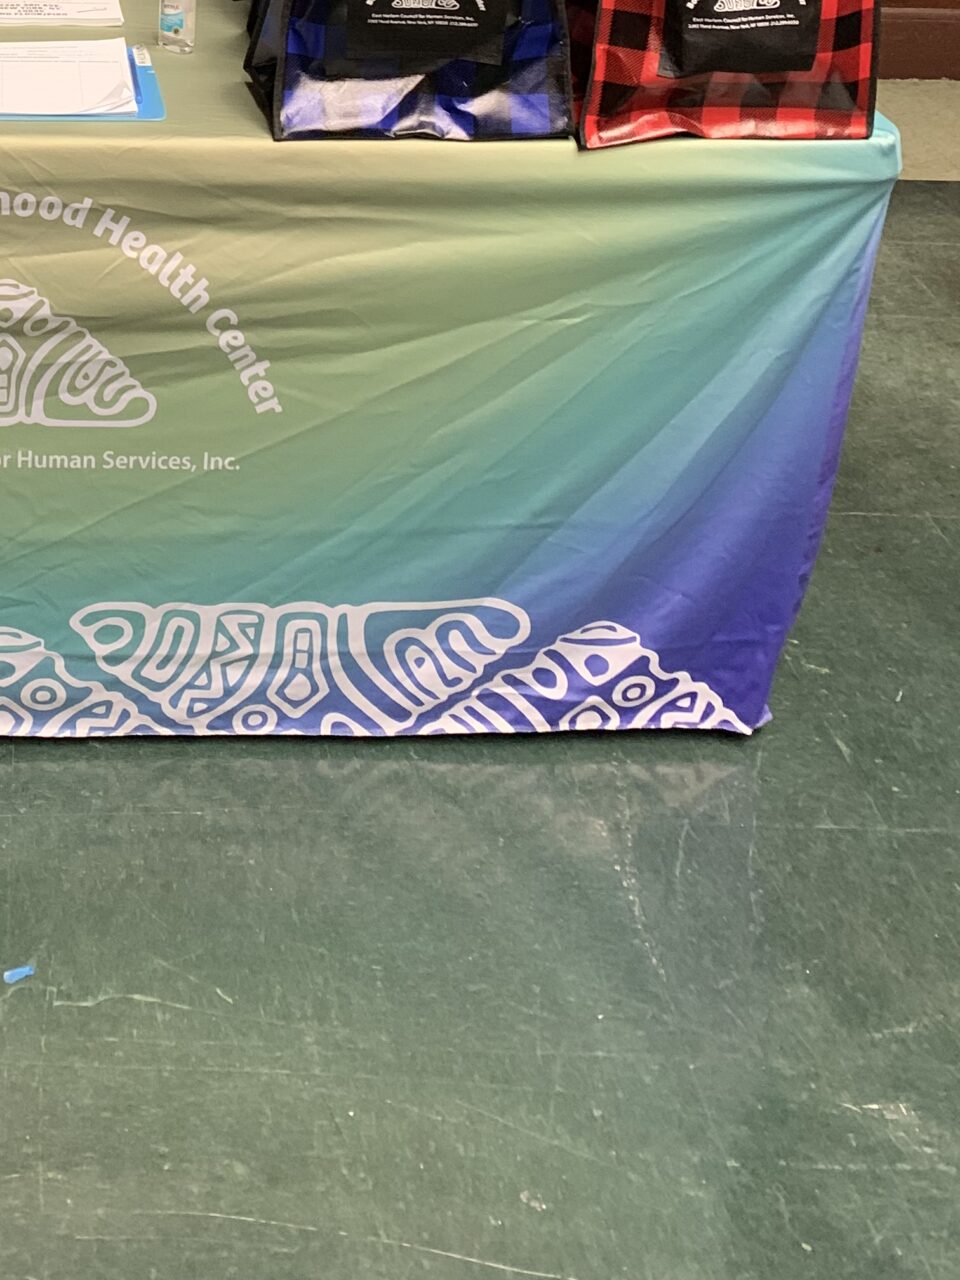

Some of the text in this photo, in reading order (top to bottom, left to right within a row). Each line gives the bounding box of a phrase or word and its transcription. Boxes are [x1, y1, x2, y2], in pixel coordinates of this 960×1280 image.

[93, 207, 210, 314] Health
[205, 308, 282, 416] Center
[17, 451, 95, 470] Human
[102, 450, 197, 473] Services,
[202, 452, 240, 471] Inc.
